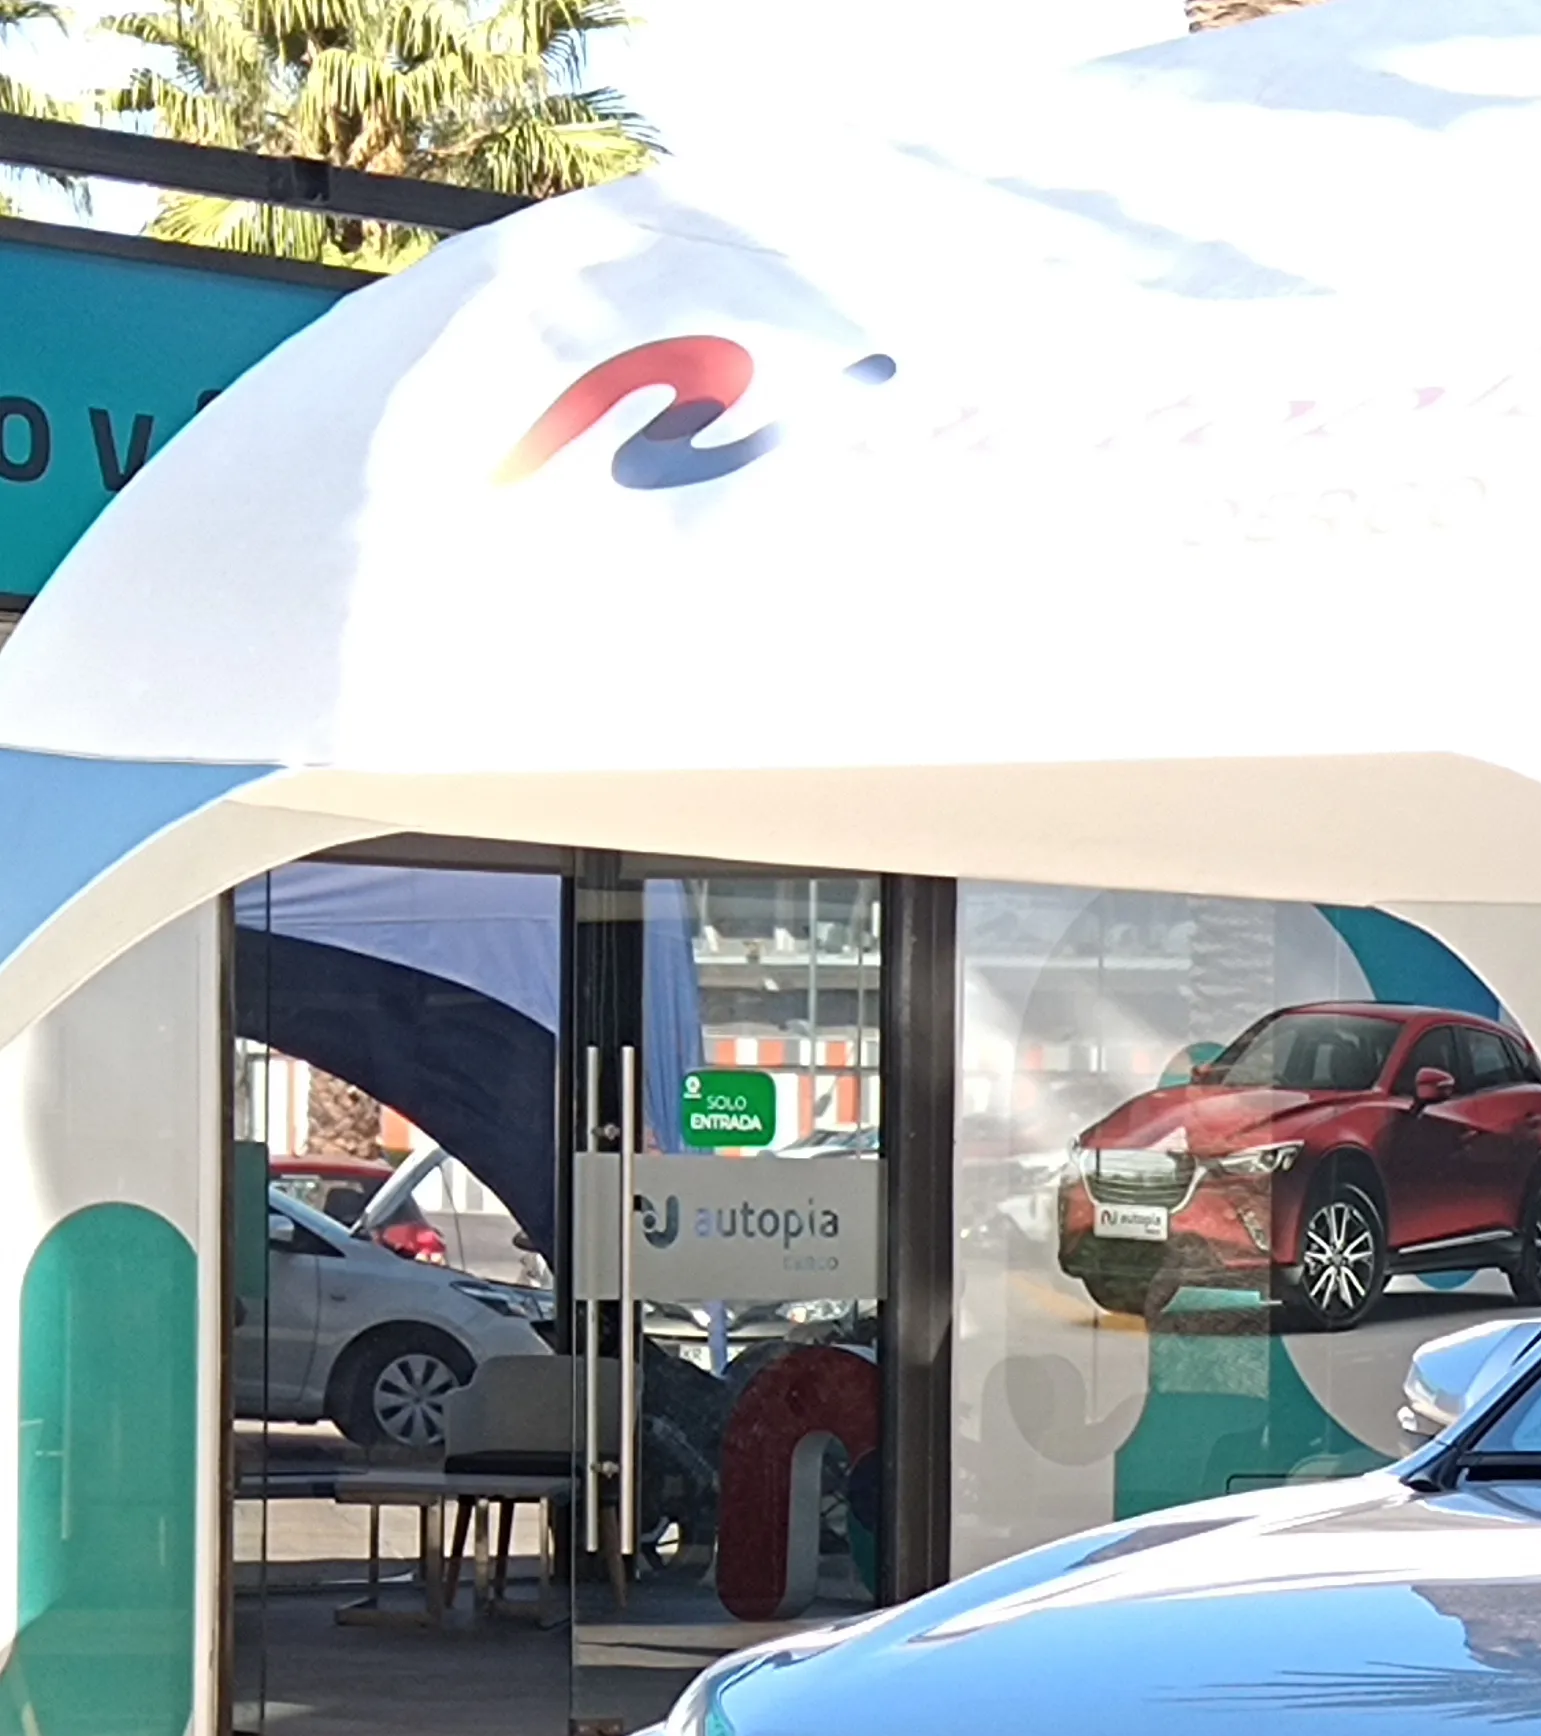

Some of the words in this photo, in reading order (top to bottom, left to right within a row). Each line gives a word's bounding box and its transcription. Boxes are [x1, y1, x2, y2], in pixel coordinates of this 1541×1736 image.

[706, 1095, 747, 1111] SOLO
[690, 1113, 763, 1131] ENTRADA
[695, 1198, 839, 1249] autopia
